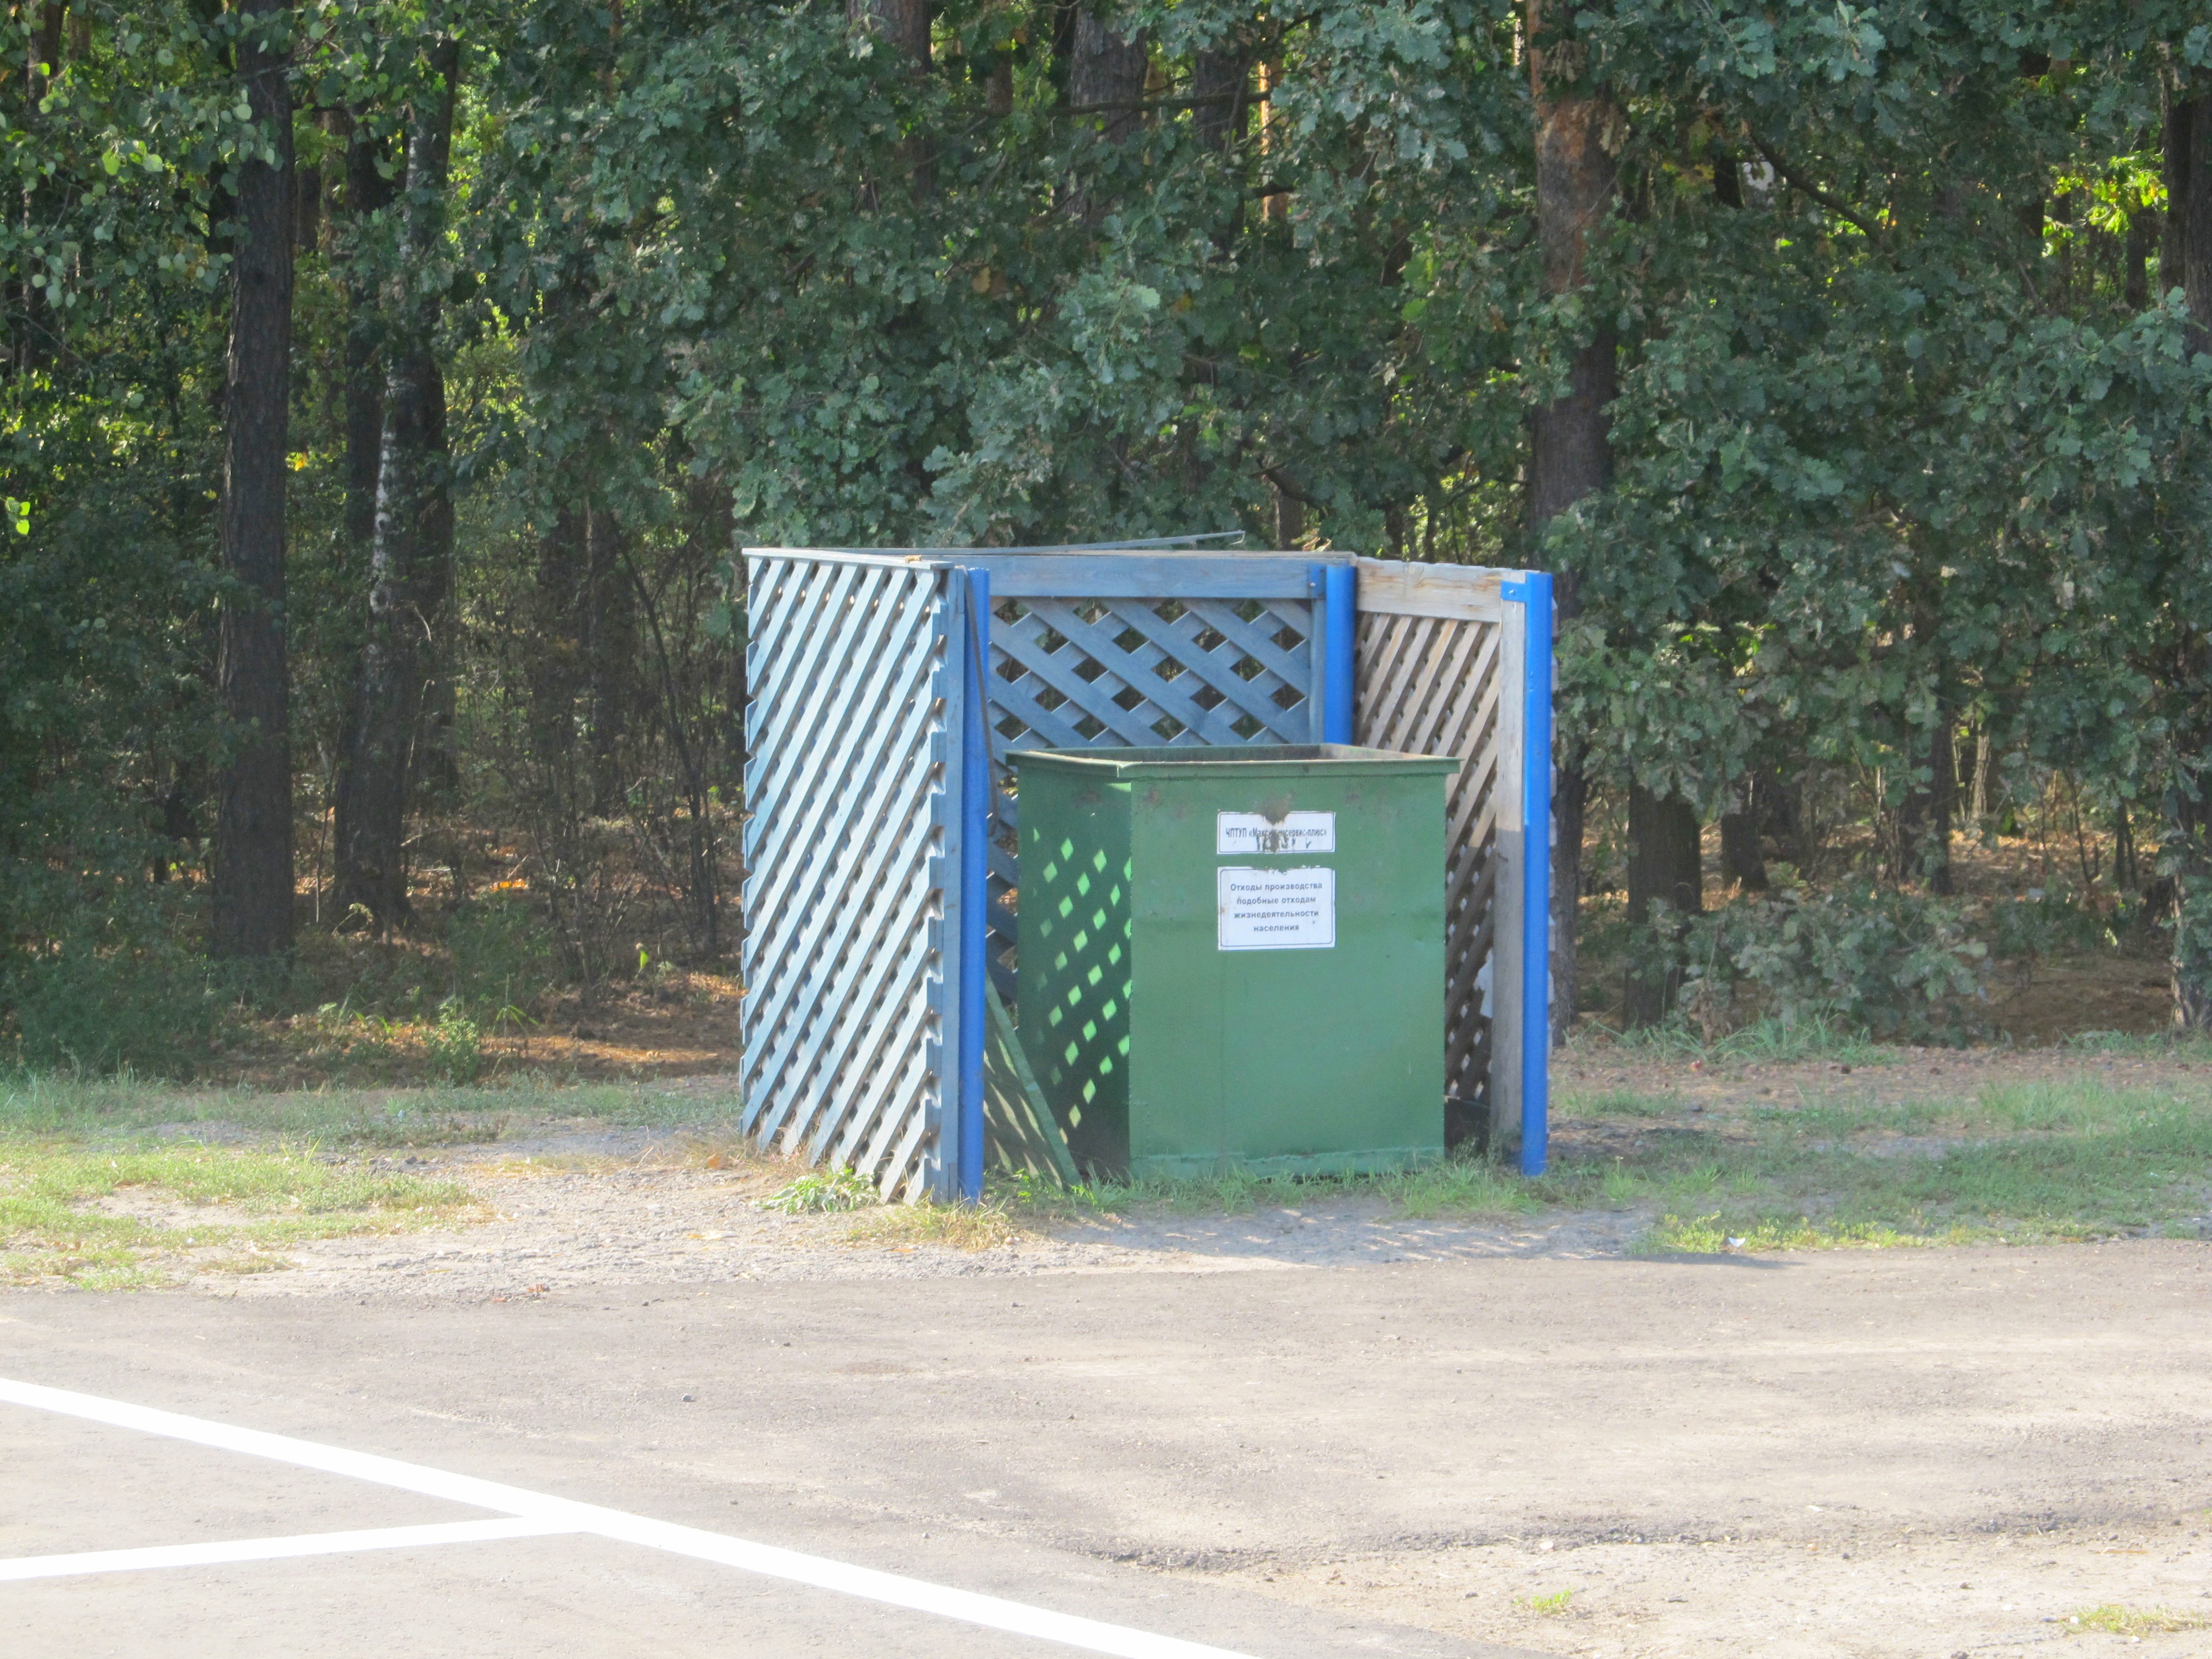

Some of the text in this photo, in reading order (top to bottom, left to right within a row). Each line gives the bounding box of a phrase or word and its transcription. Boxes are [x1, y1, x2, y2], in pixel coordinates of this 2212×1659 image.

[1225, 828, 1247, 838] ЧПТУП
[1265, 882, 1323, 891] производства
[1237, 896, 1279, 905] подобные
[1234, 911, 1319, 920] жизнедеятельности
